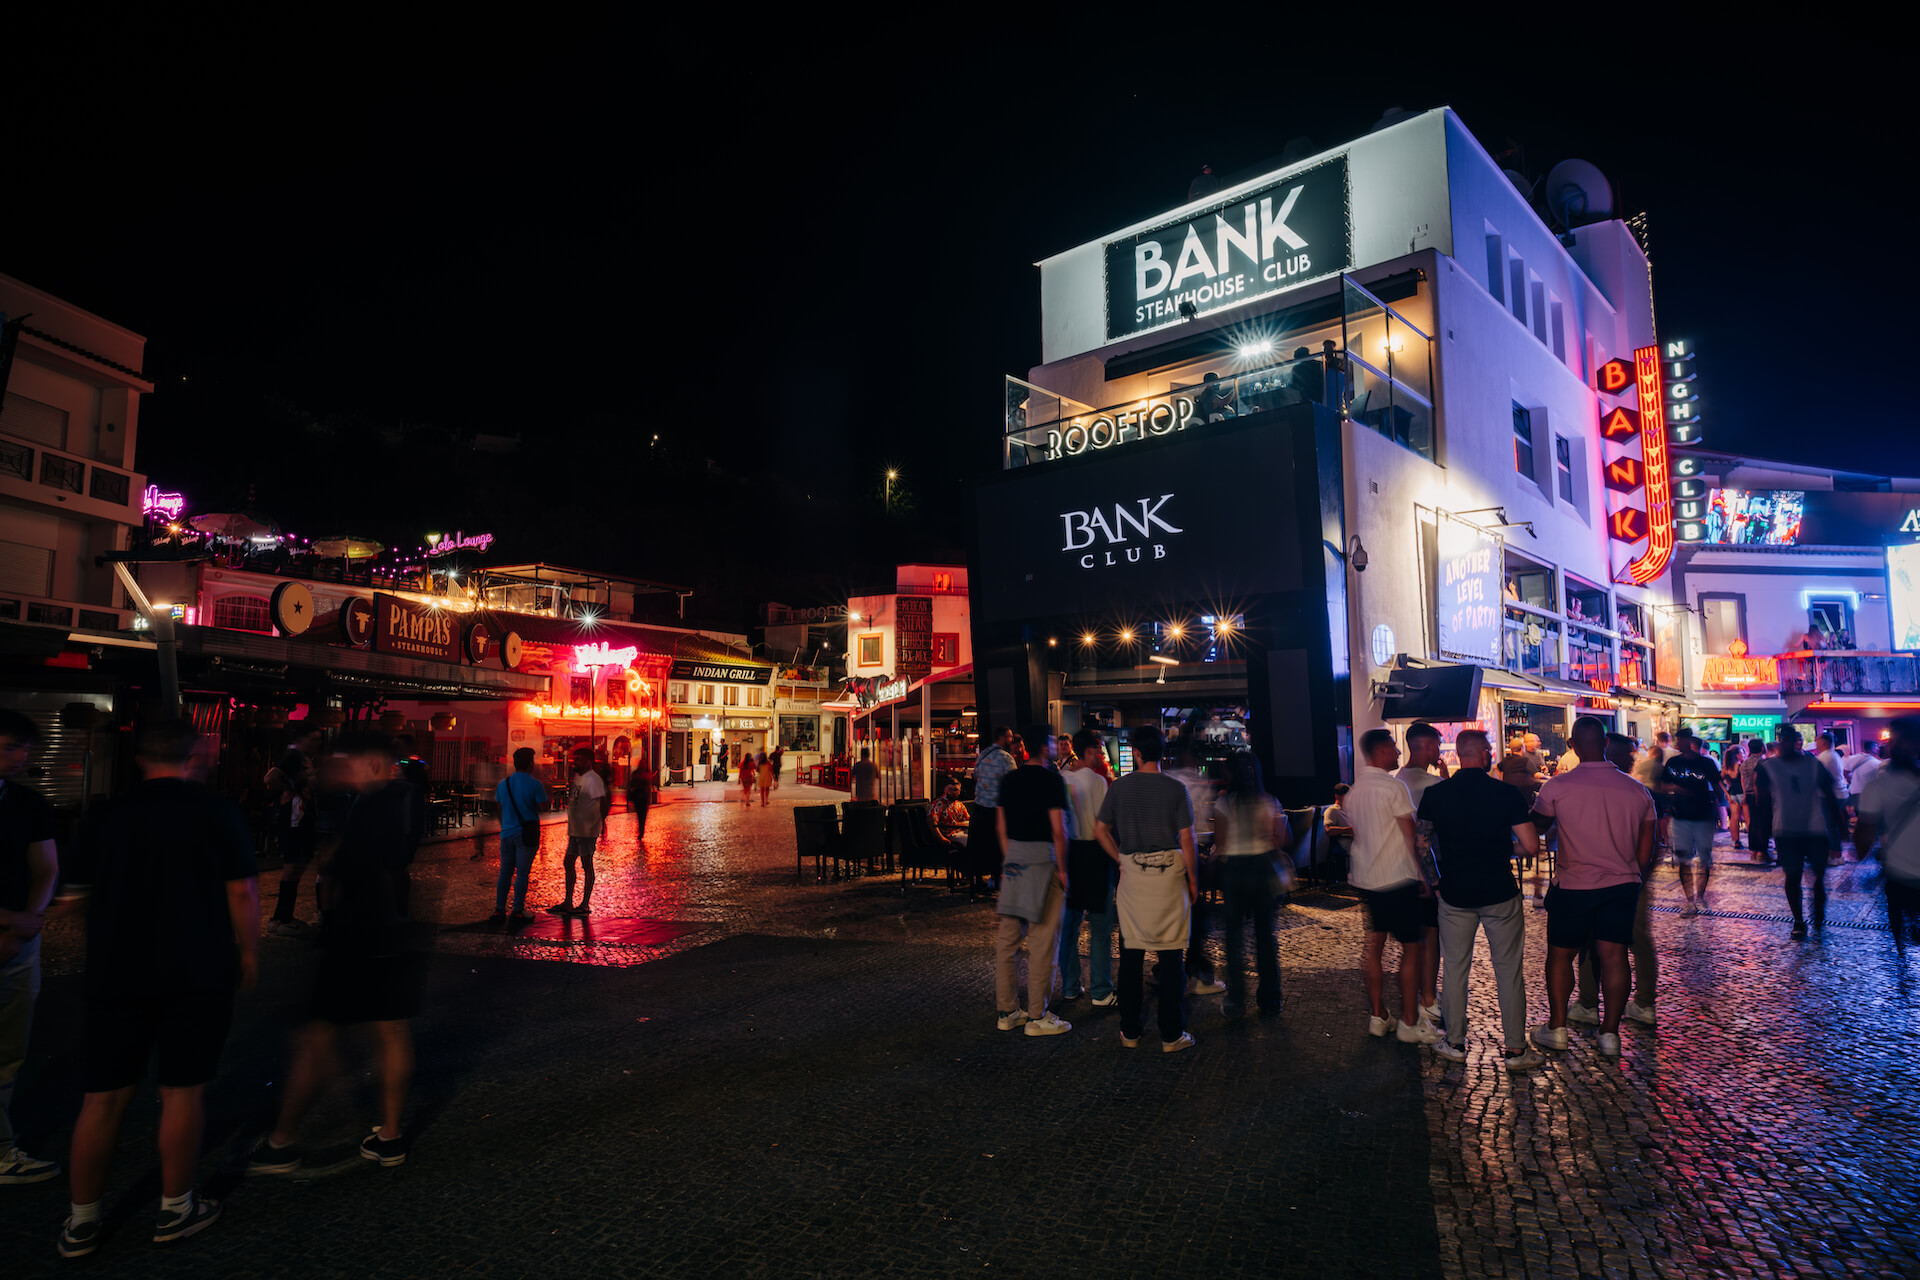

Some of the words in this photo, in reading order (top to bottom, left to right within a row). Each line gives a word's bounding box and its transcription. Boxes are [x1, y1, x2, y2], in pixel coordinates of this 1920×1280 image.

[1136, 185, 1309, 301] BANK
[1135, 274, 1245, 323] STEAKHOUSE
[1263, 254, 1311, 283] CLUB
[1669, 341, 1690, 441] NIGHT
[1047, 397, 1194, 461] ROOFTOP
[1605, 361, 1639, 538] BANK
[1679, 460, 1699, 539] CLUB
[1060, 493, 1183, 552] BANK
[457, 530, 493, 550] Lounge
[1080, 544, 1167, 570] CLUB
[1445, 548, 1491, 587] ANOTHER
[1457, 577, 1484, 605] LEVEL
[389, 604, 452, 646] PAMPAS
[801, 604, 848, 620] ROOFTO
[901, 614, 927, 631] STEAK
[1452, 609, 1463, 633] OF
[1466, 605, 1496, 632] PARTY!
[397, 641, 443, 656] STEAKHOUSE
[901, 631, 926, 648] HOUSE
[692, 666, 729, 679] INDIAN
[729, 669, 756, 680] GRILL
[1732, 717, 1772, 727] RAOKE
